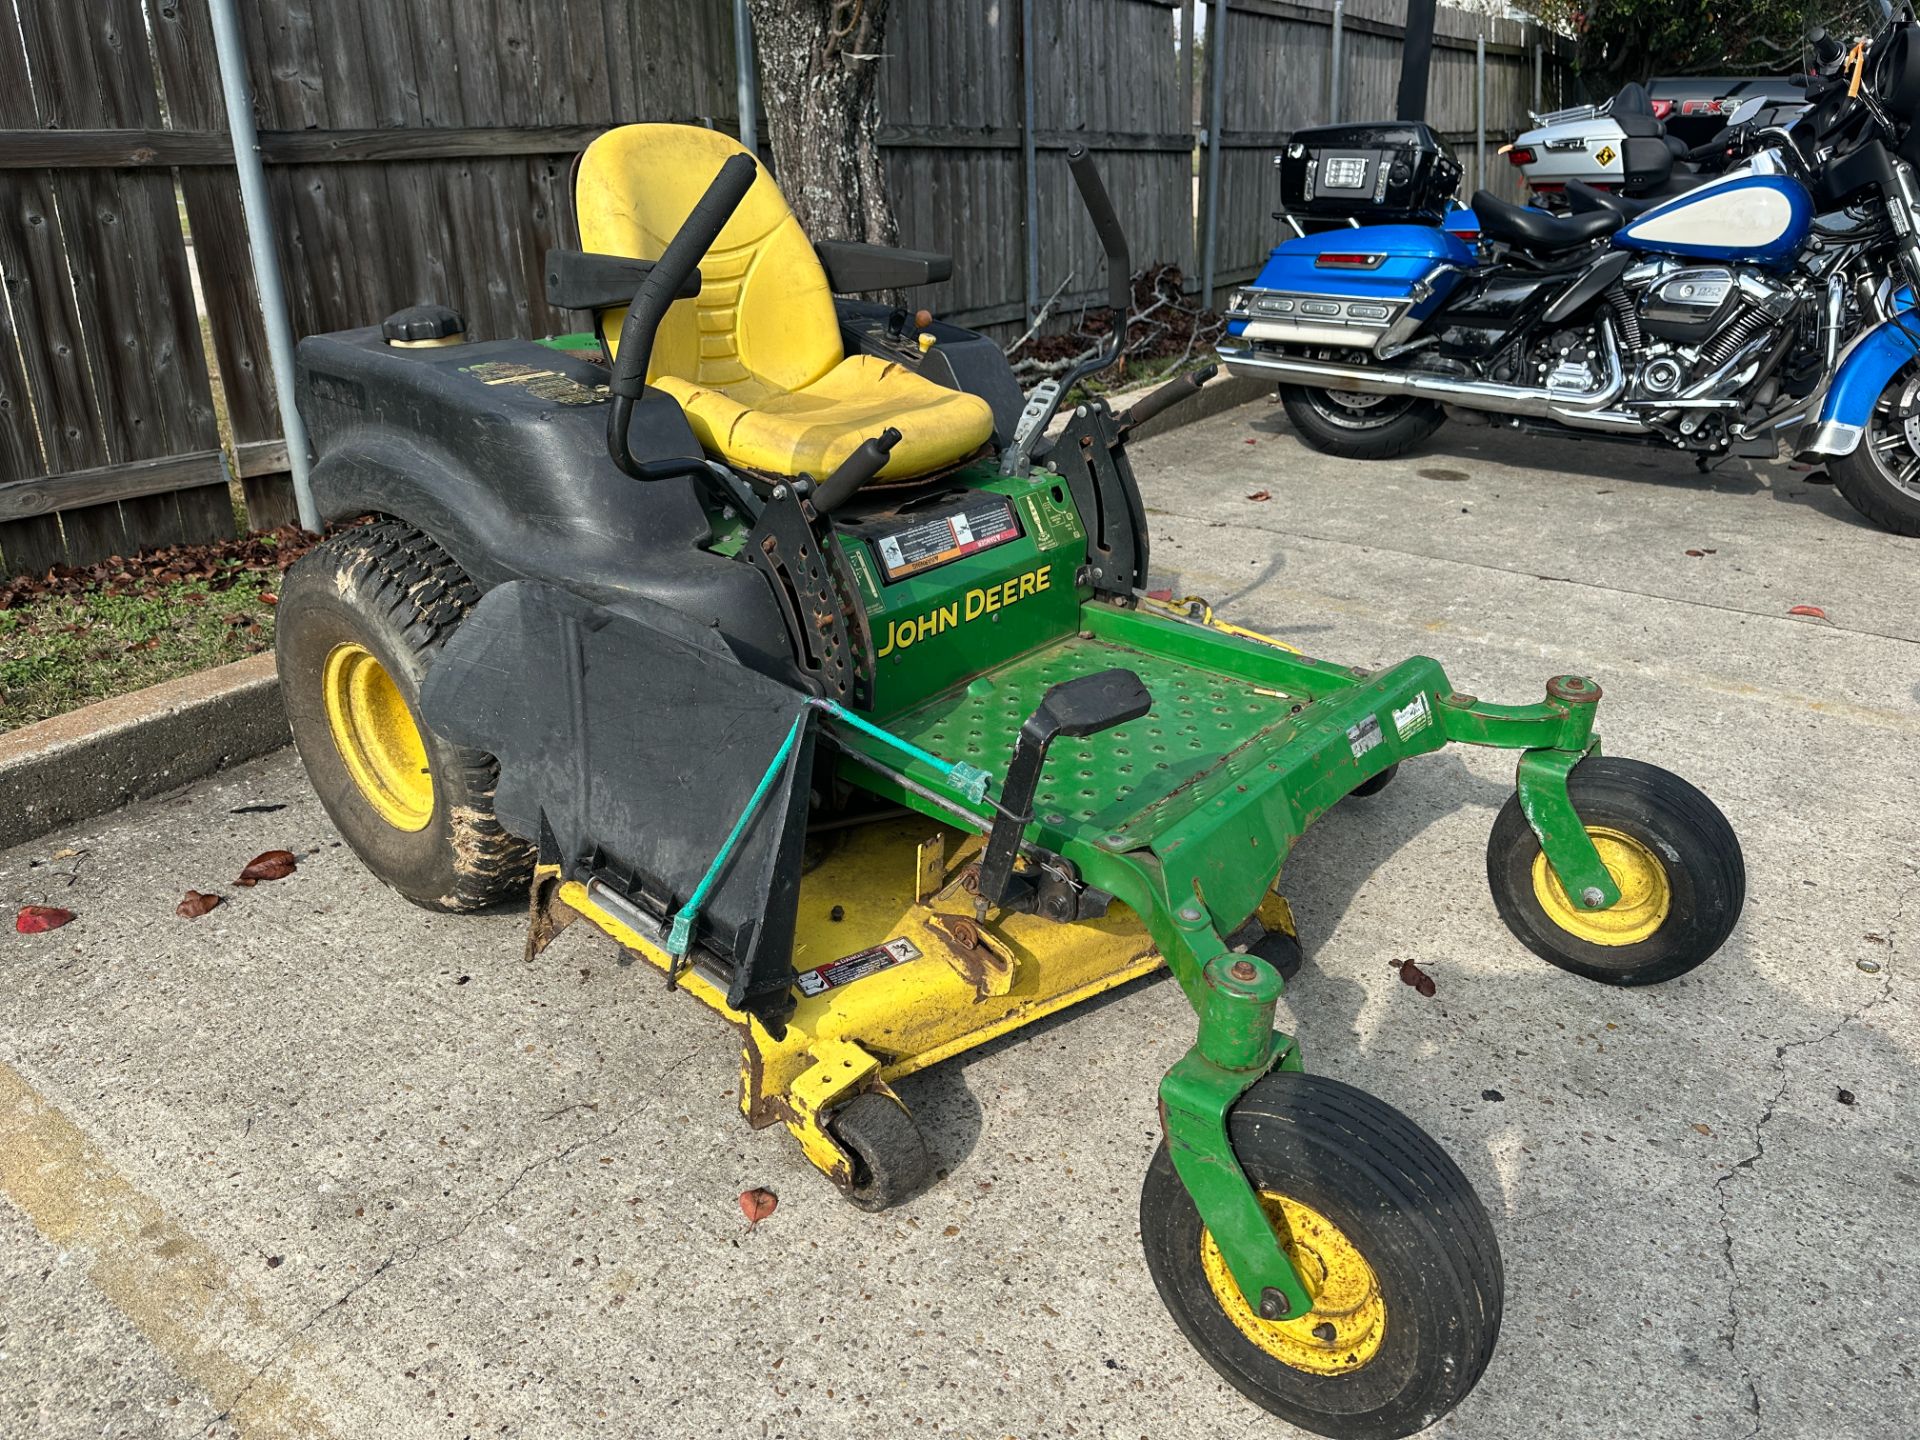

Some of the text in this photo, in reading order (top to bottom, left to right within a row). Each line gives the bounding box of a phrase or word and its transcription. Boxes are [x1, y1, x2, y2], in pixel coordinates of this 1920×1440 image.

[1682, 99, 1743, 115] FX4
[877, 565, 1052, 659] JOHN DEERE
